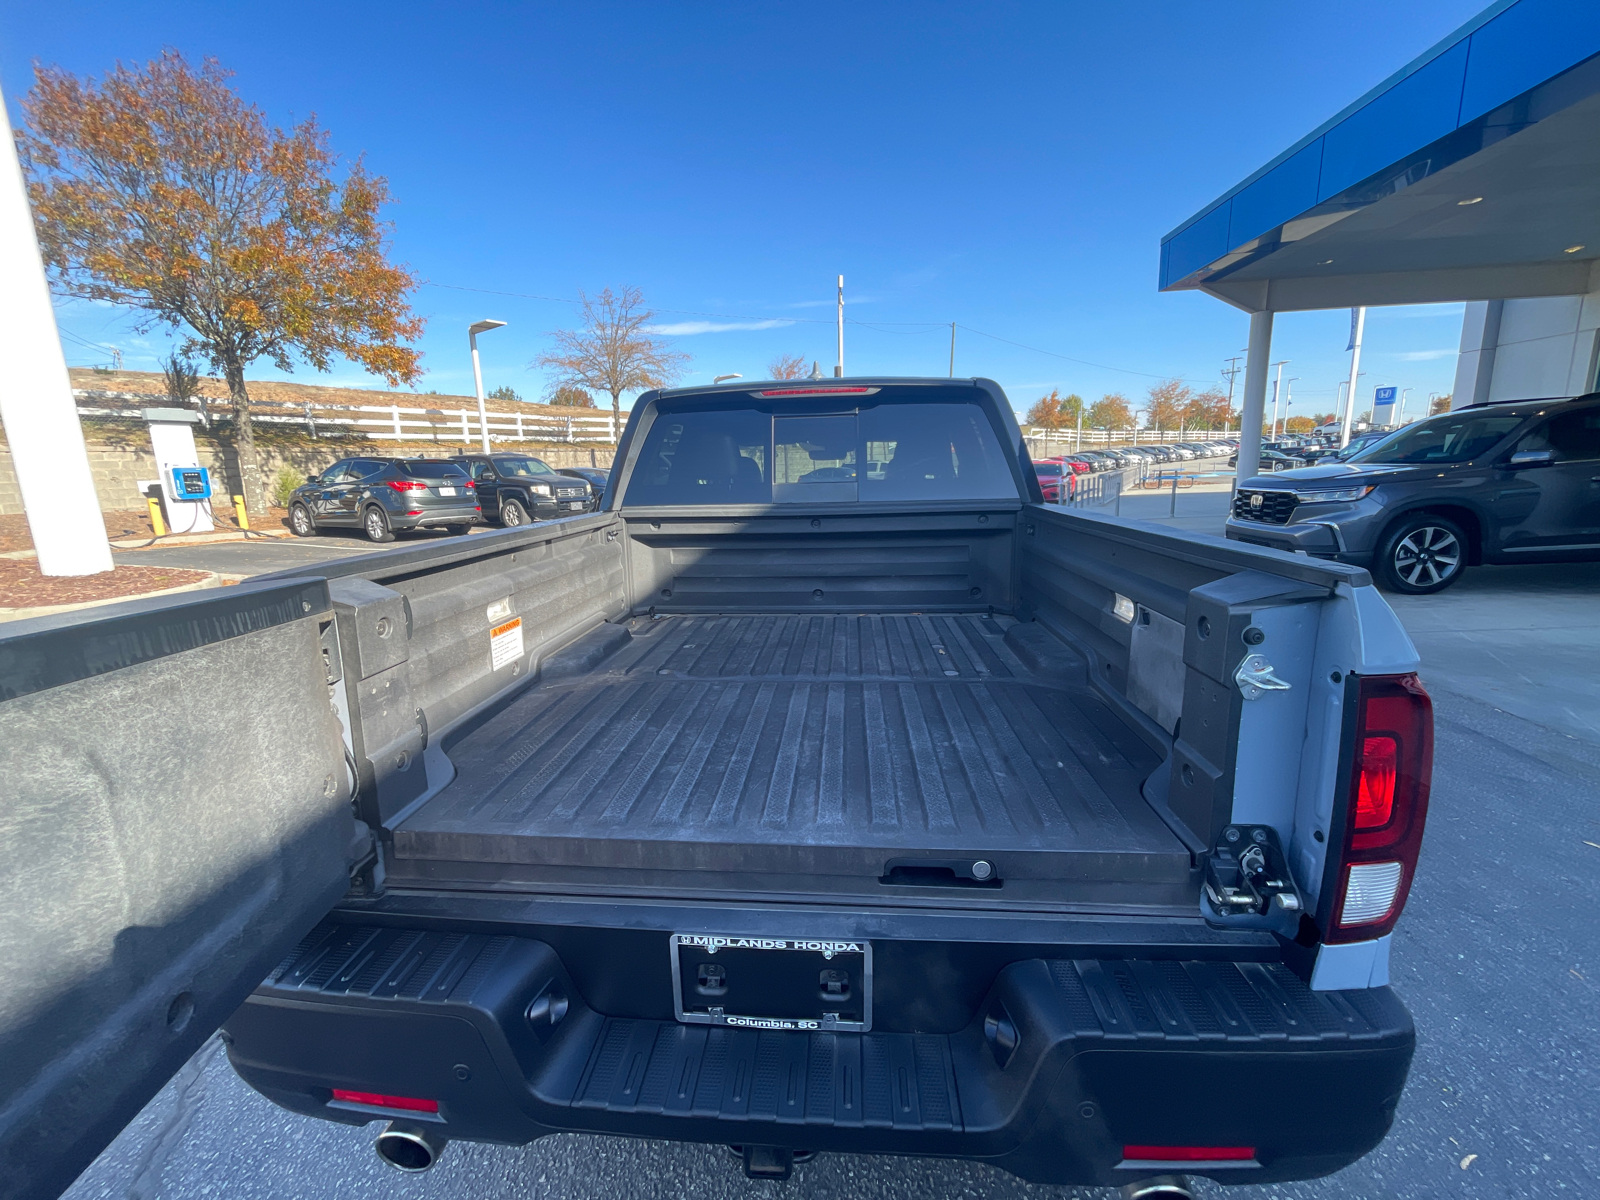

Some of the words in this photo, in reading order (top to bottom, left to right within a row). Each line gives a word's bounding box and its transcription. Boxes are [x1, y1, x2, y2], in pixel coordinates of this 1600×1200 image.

[499, 619, 520, 635] WARNING
[693, 936, 787, 949] MIDLANDS
[794, 941, 860, 951] HONDA
[726, 1017, 795, 1029] Columbia,
[798, 1021, 818, 1029] SC
